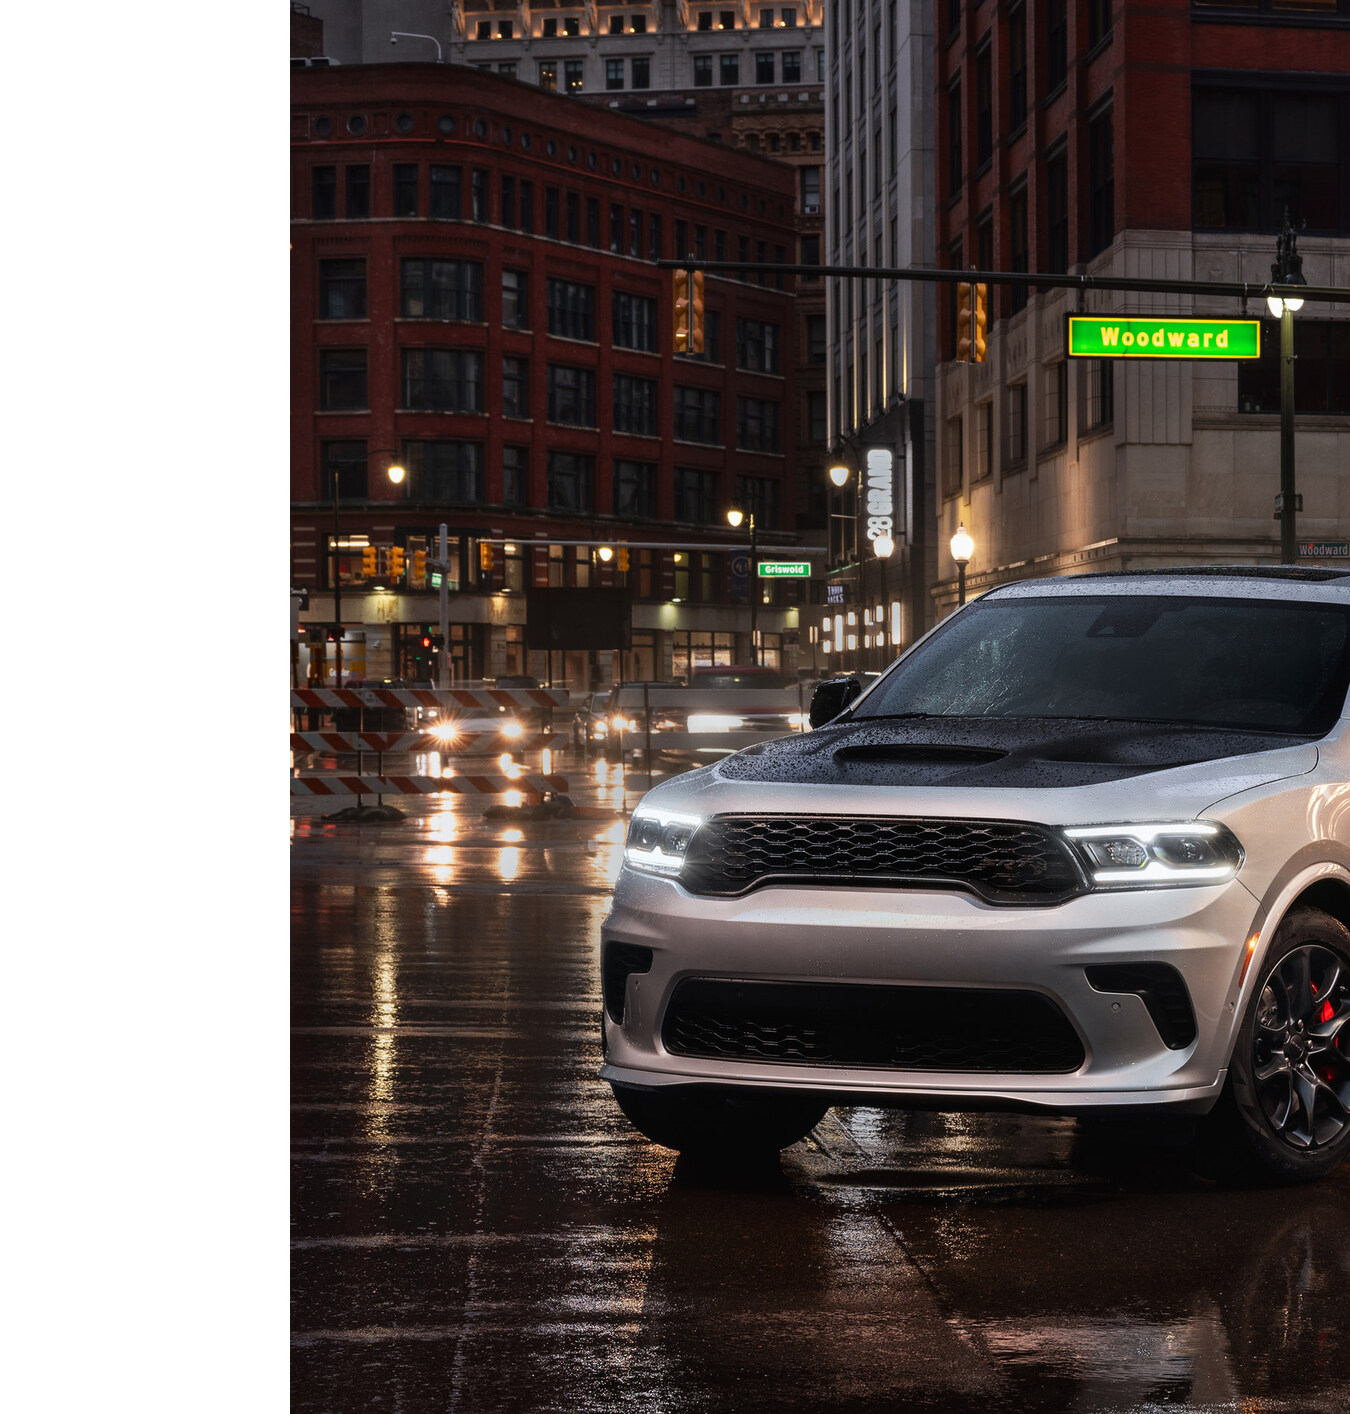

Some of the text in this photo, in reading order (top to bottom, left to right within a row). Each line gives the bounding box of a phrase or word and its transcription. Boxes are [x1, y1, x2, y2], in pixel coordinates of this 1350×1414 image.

[1100, 326, 1229, 349] Woodward
[866, 449, 893, 541] 28 GRAND
[1299, 544, 1348, 555] Woodward
[764, 565, 804, 574] Griswold
